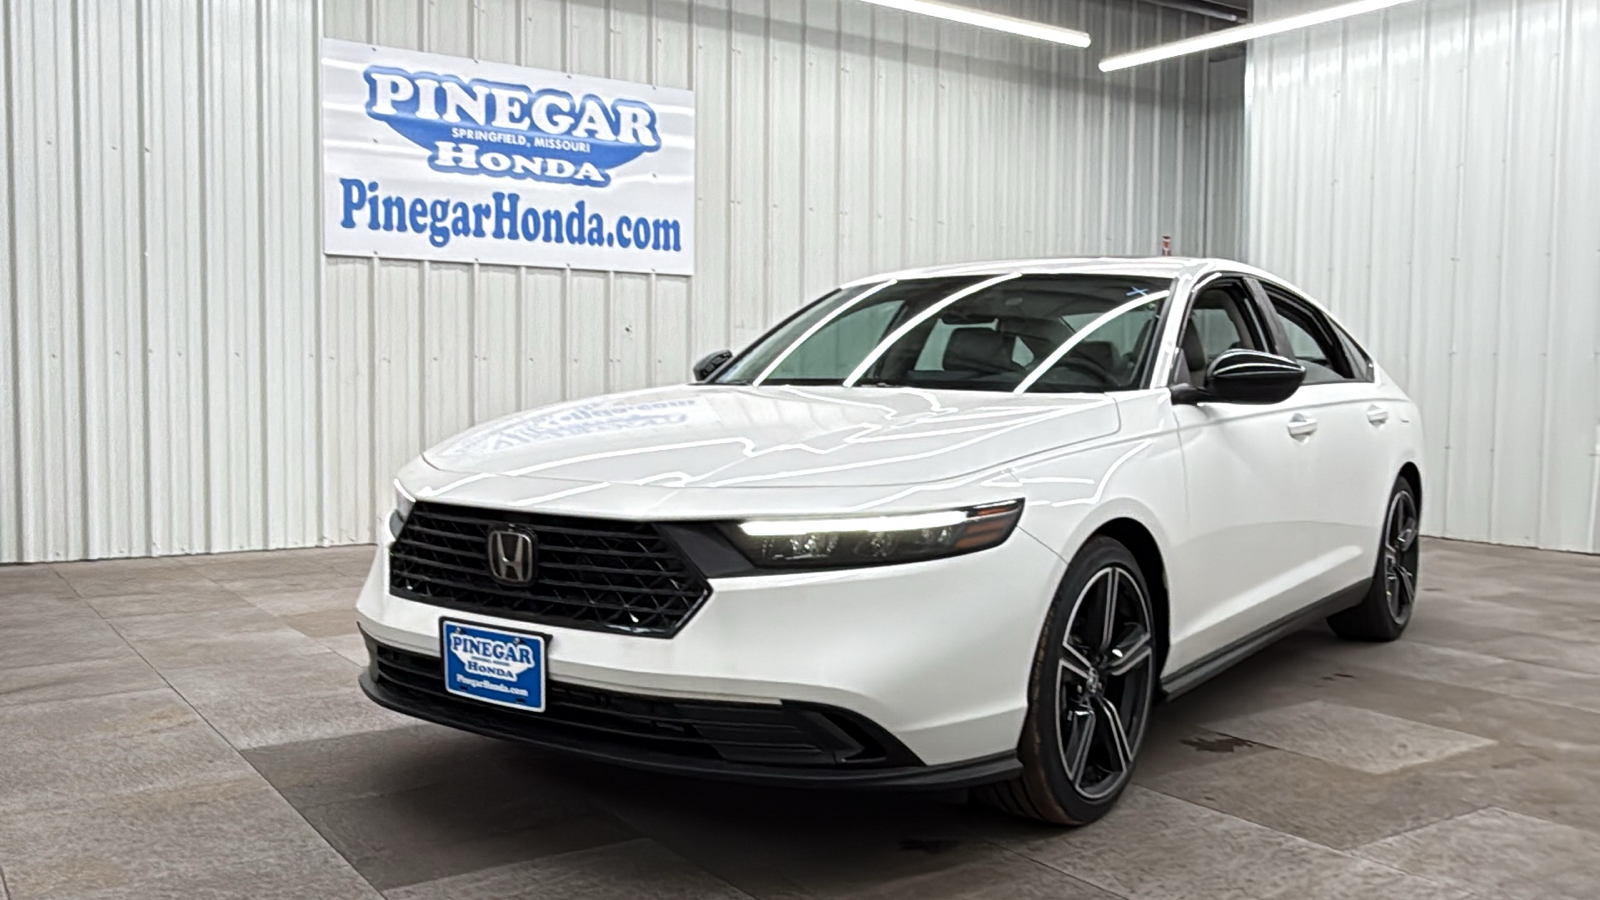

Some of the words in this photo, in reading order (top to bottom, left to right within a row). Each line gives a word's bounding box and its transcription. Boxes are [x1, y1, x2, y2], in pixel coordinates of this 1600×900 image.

[369, 72, 658, 147] PINEGAR
[452, 126, 531, 148] SPRINGFIELD,
[533, 136, 591, 153] MISSOURI
[339, 178, 682, 251] PinegarHonda.com
[452, 636, 532, 665] PINEGAR
